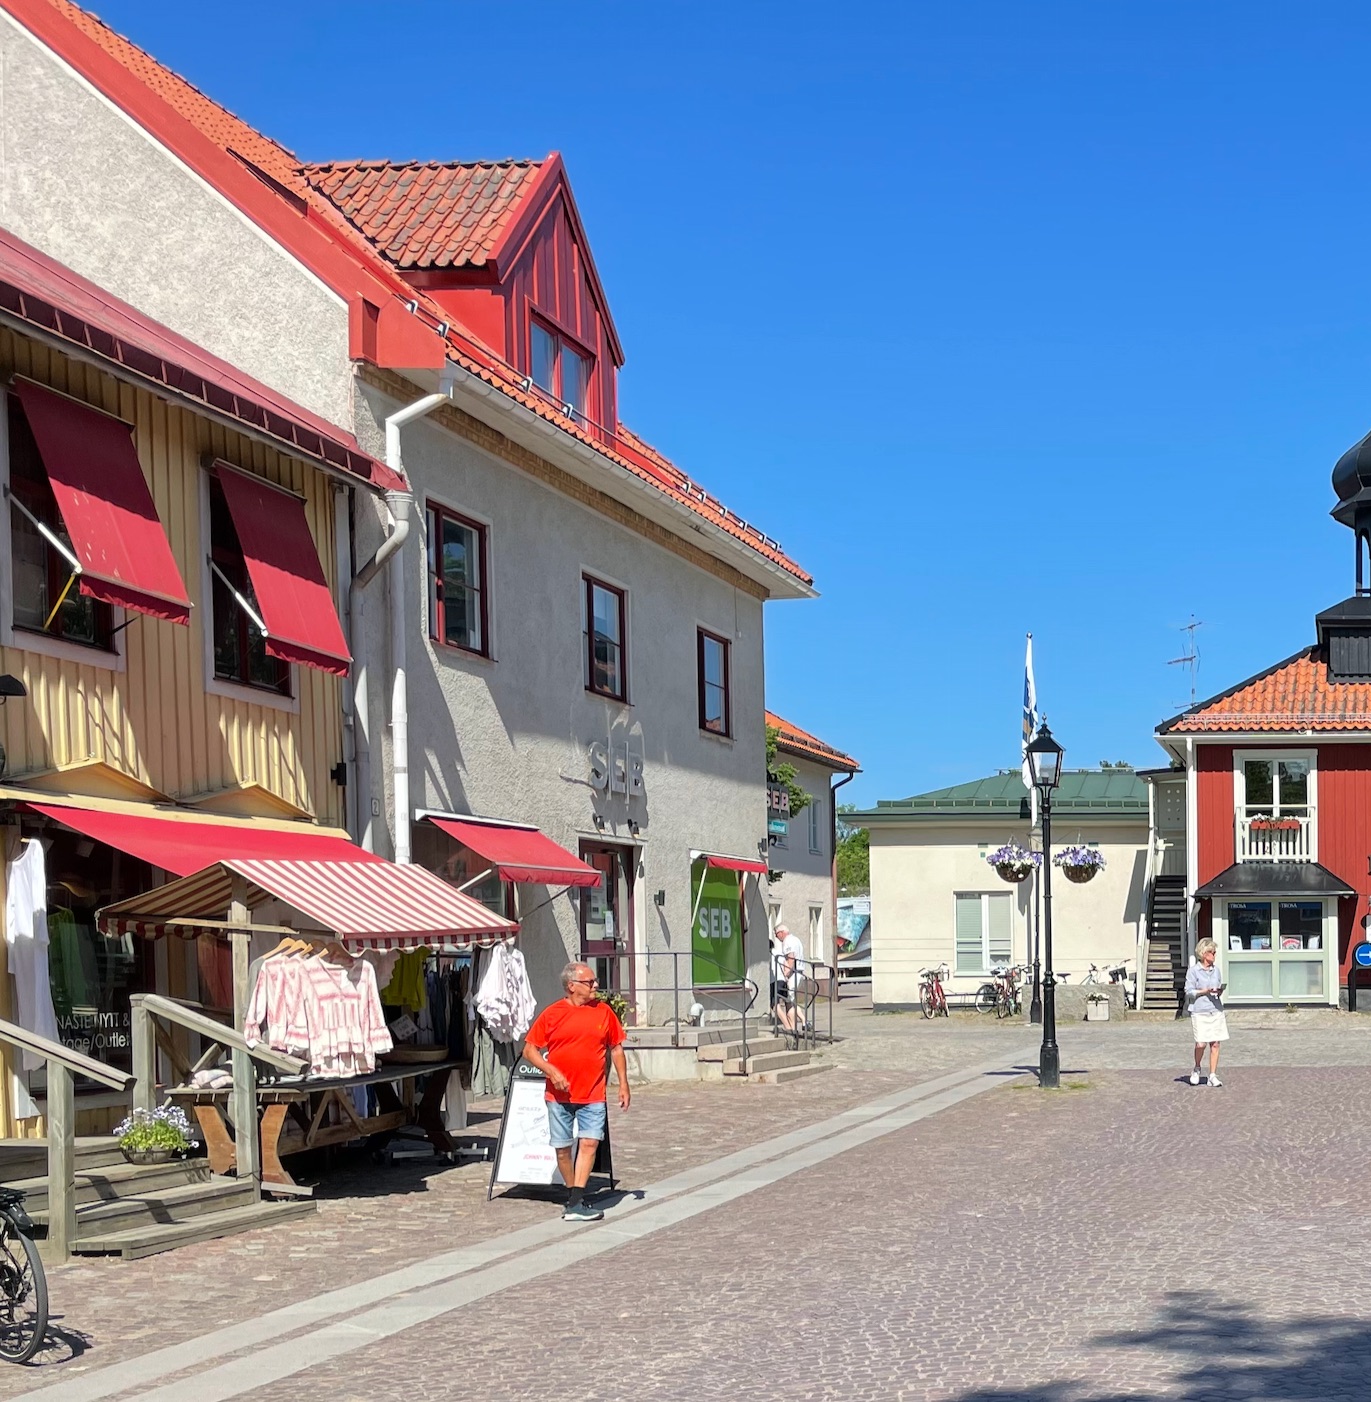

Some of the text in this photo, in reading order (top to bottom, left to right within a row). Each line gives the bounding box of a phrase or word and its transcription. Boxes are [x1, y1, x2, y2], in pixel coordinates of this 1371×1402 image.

[588, 741, 644, 796] SEB
[699, 907, 731, 938] SEB
[56, 1014, 91, 1030] NASTE
[62, 1032, 129, 1050] tage/Outlet
[520, 1064, 542, 1074] Outle
